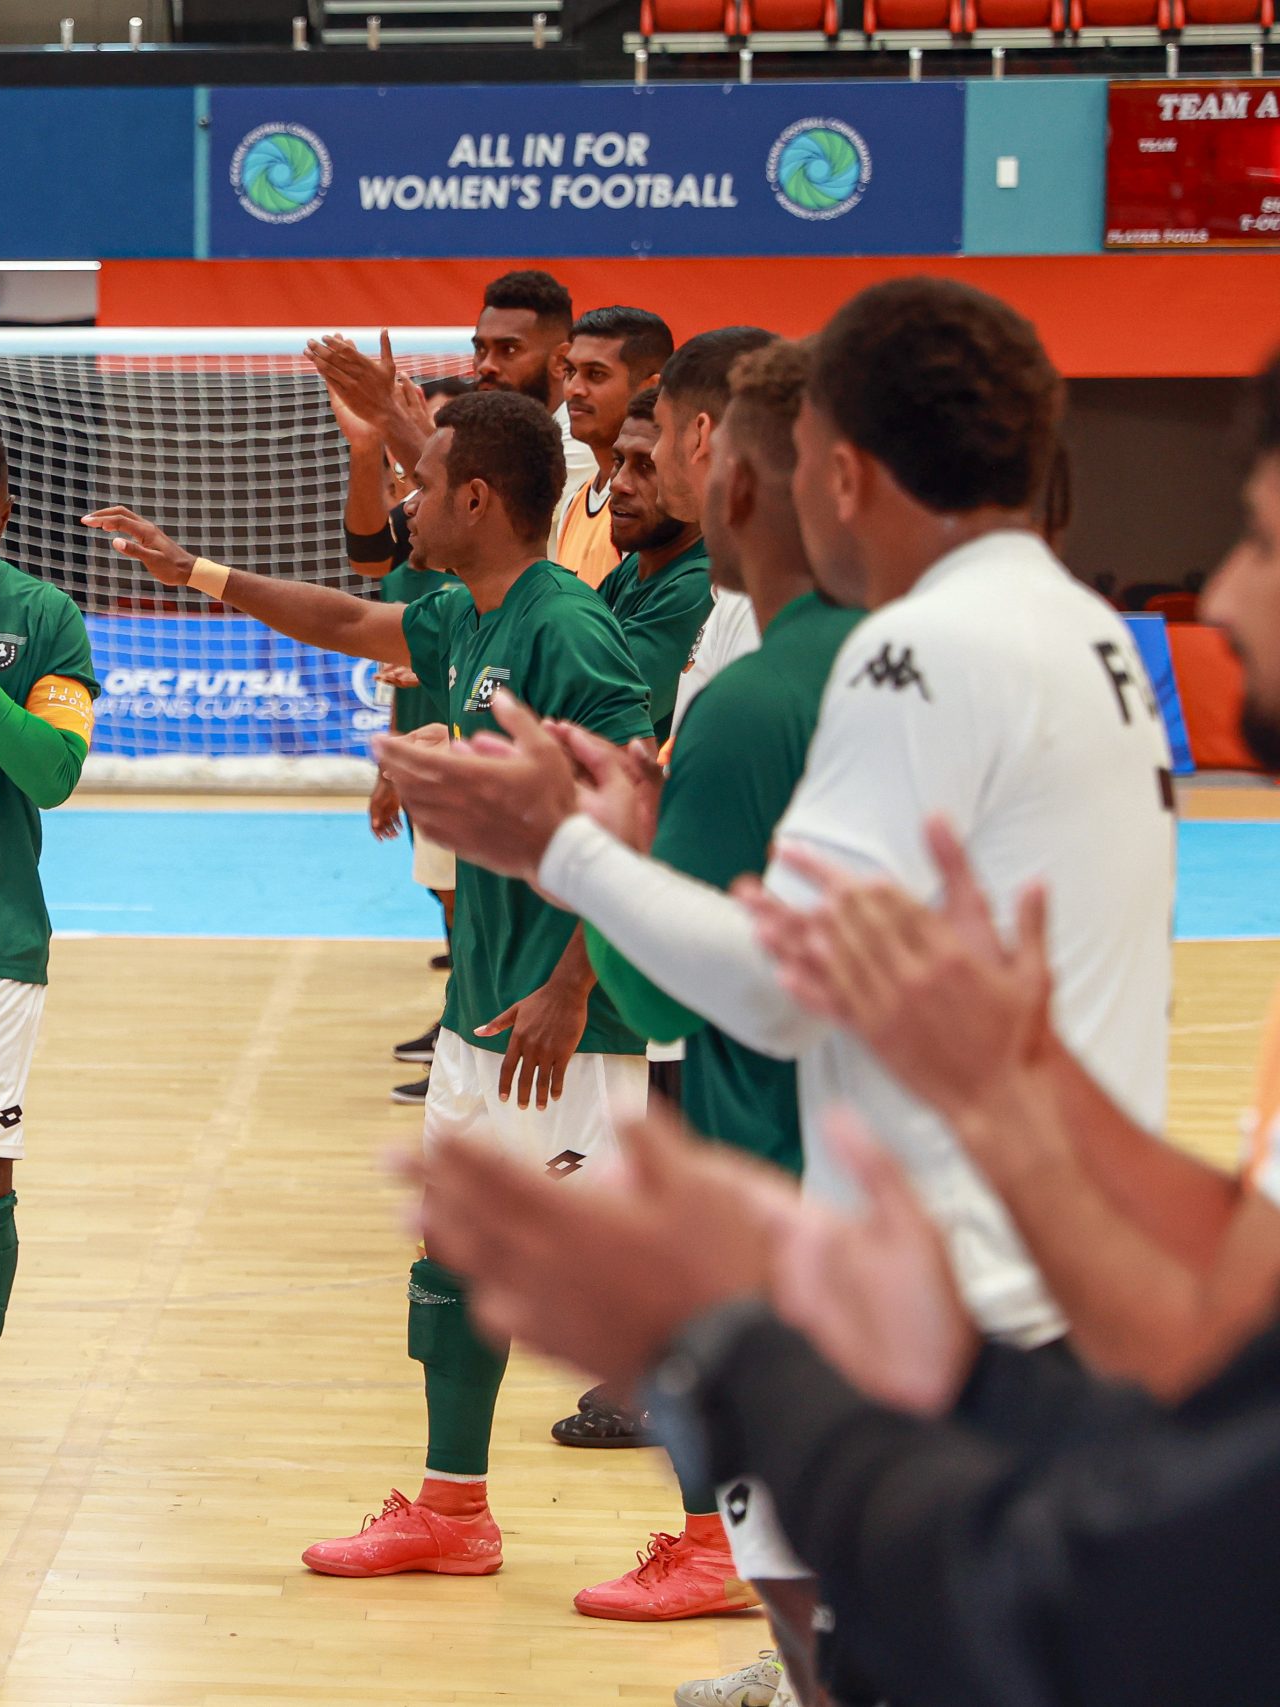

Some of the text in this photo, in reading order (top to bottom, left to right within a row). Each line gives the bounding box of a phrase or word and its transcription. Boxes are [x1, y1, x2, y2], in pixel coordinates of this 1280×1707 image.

[1157, 92, 1251, 121] TEAM
[447, 131, 651, 168] ALL IN FOR
[359, 172, 739, 210] WOMEN'S FOOTBALL
[1162, 227, 1210, 243] FOULS
[104, 667, 308, 698] OFC FUTSAL
[94, 696, 194, 720] ATIONS
[195, 696, 253, 720] CUP
[352, 709, 391, 731] OF
